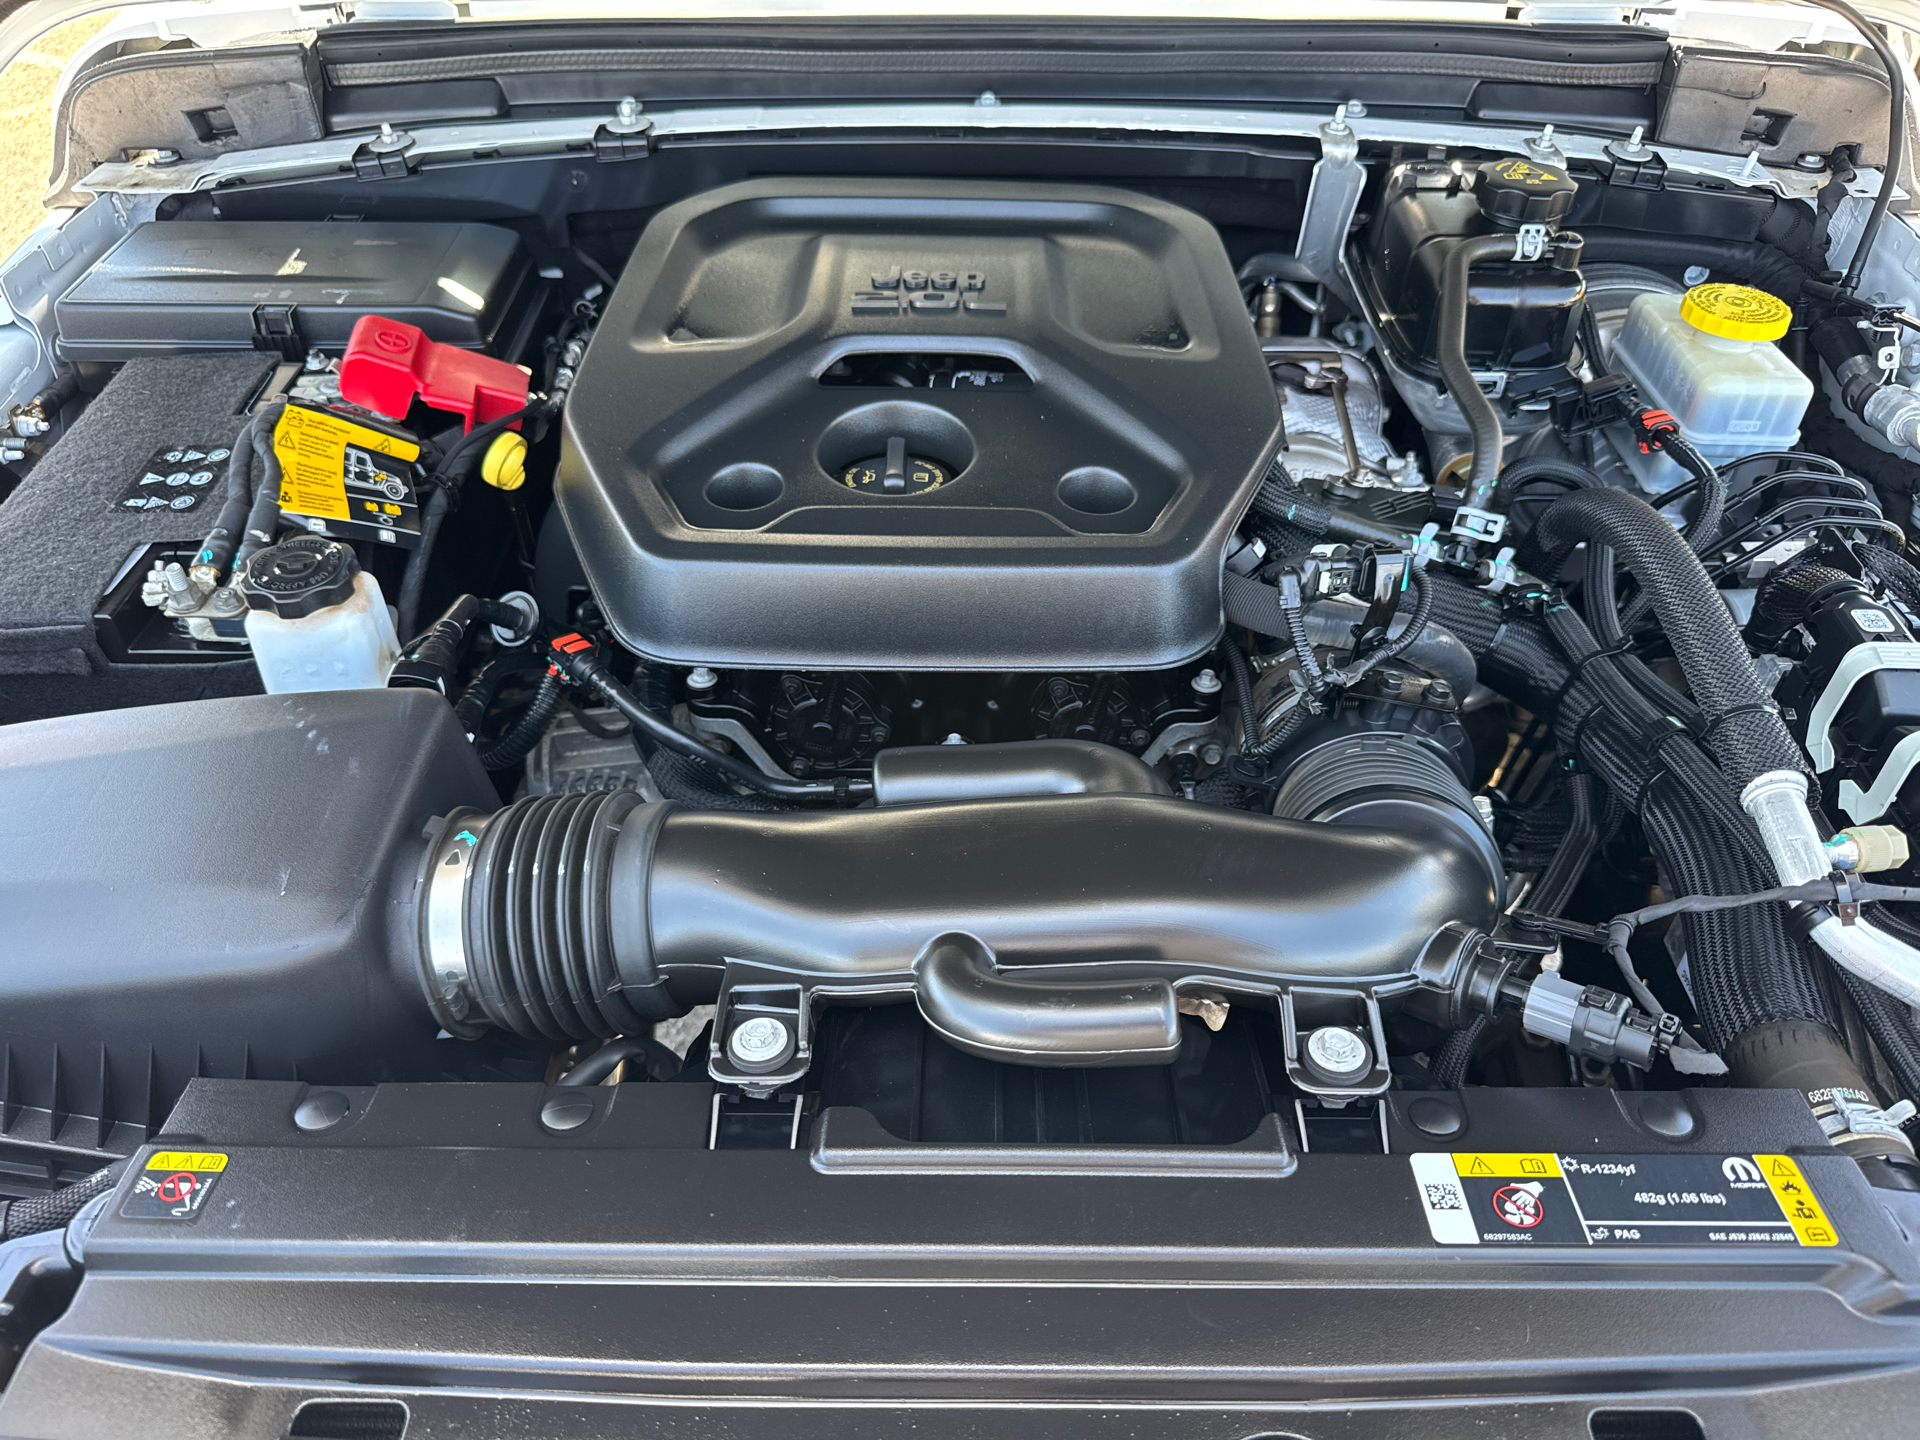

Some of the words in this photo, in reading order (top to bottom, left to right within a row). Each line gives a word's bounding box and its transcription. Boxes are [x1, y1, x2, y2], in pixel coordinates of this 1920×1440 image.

[871, 266, 986, 292] Jeep
[851, 291, 1007, 316] 2.0L
[1580, 1164, 1636, 1176] R-1234yf
[1634, 1192, 1667, 1206] 482g
[1667, 1192, 1700, 1206] (1.06
[1700, 1192, 1726, 1206] lbs)
[1614, 1229, 1641, 1240] PAG
[1708, 1232, 1728, 1240] SAE
